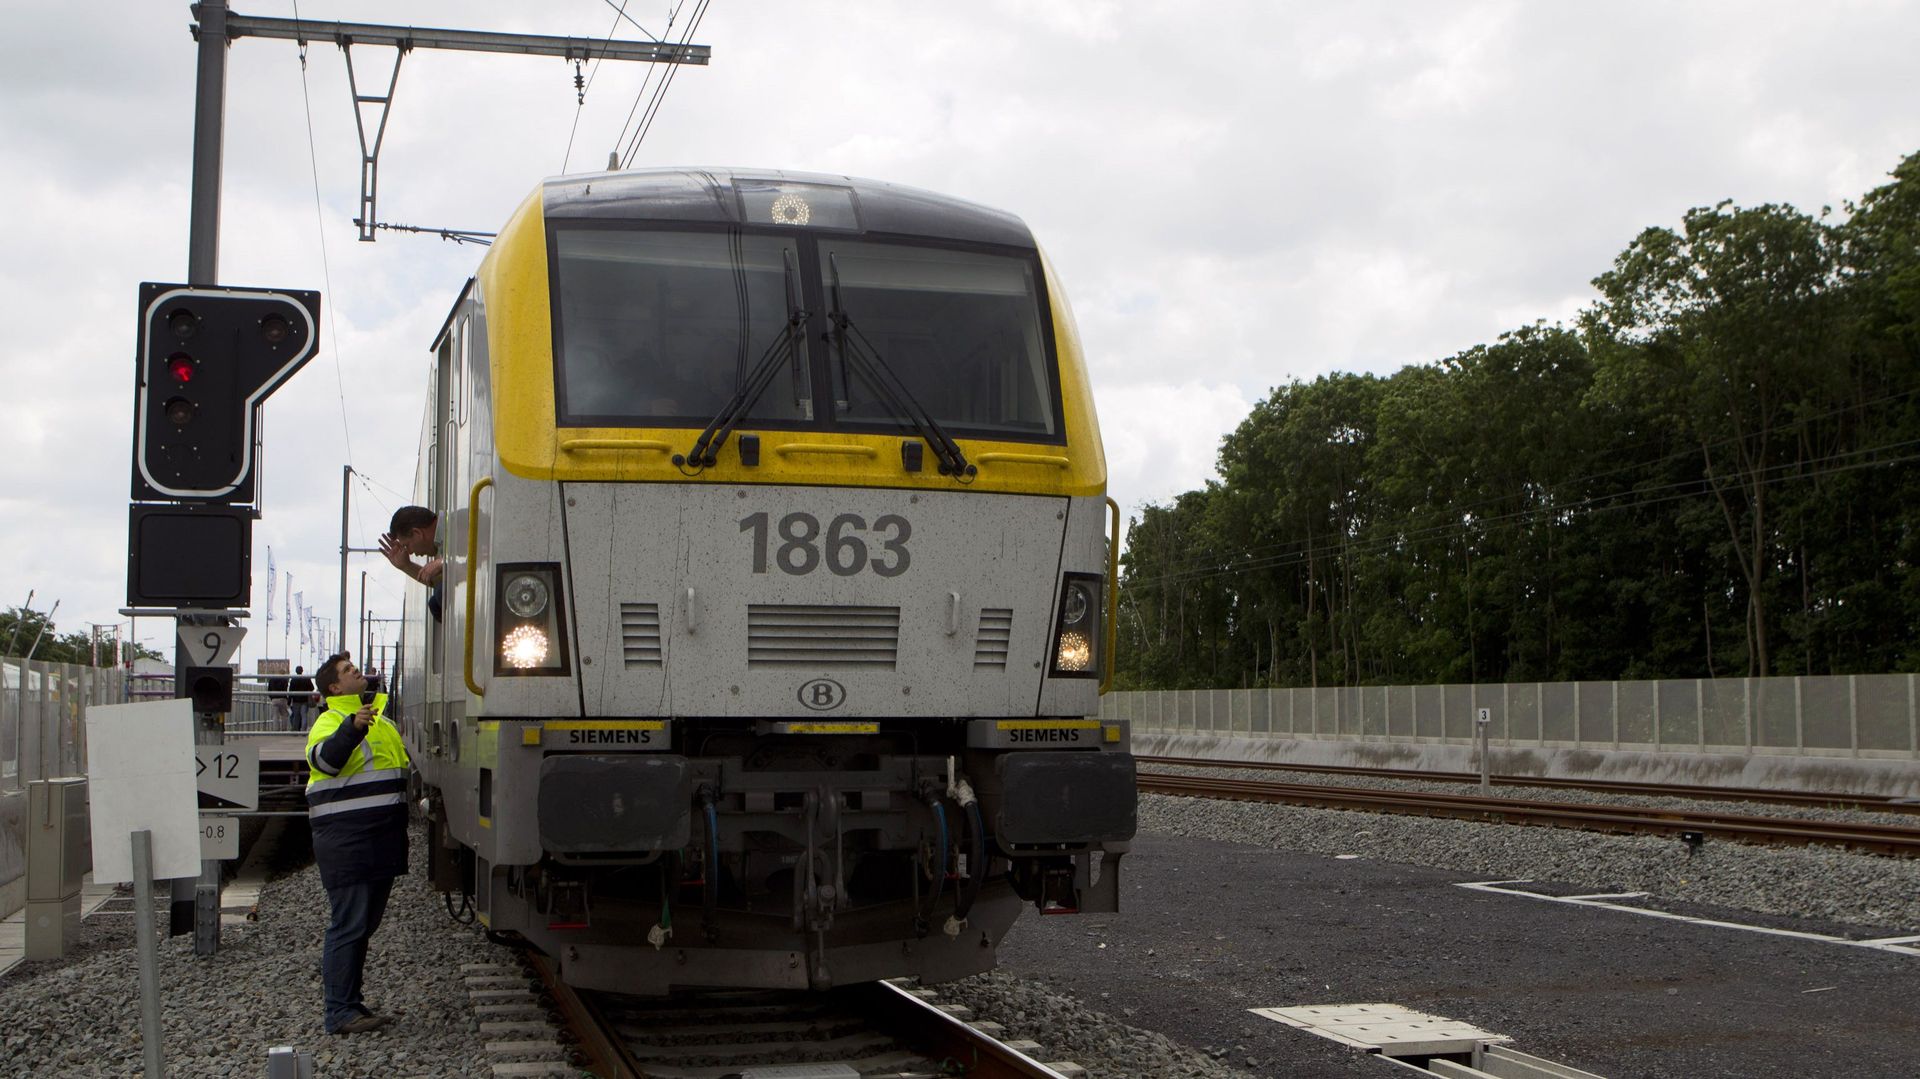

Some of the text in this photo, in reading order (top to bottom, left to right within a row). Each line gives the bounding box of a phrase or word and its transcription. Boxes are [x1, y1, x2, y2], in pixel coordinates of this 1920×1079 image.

[740, 511, 912, 577] 1863
[203, 632, 221, 665] 9
[811, 683, 834, 706] B
[1481, 710, 1487, 720] 3
[569, 729, 651, 744] SIEMENS
[1010, 728, 1079, 742] SIEMENS
